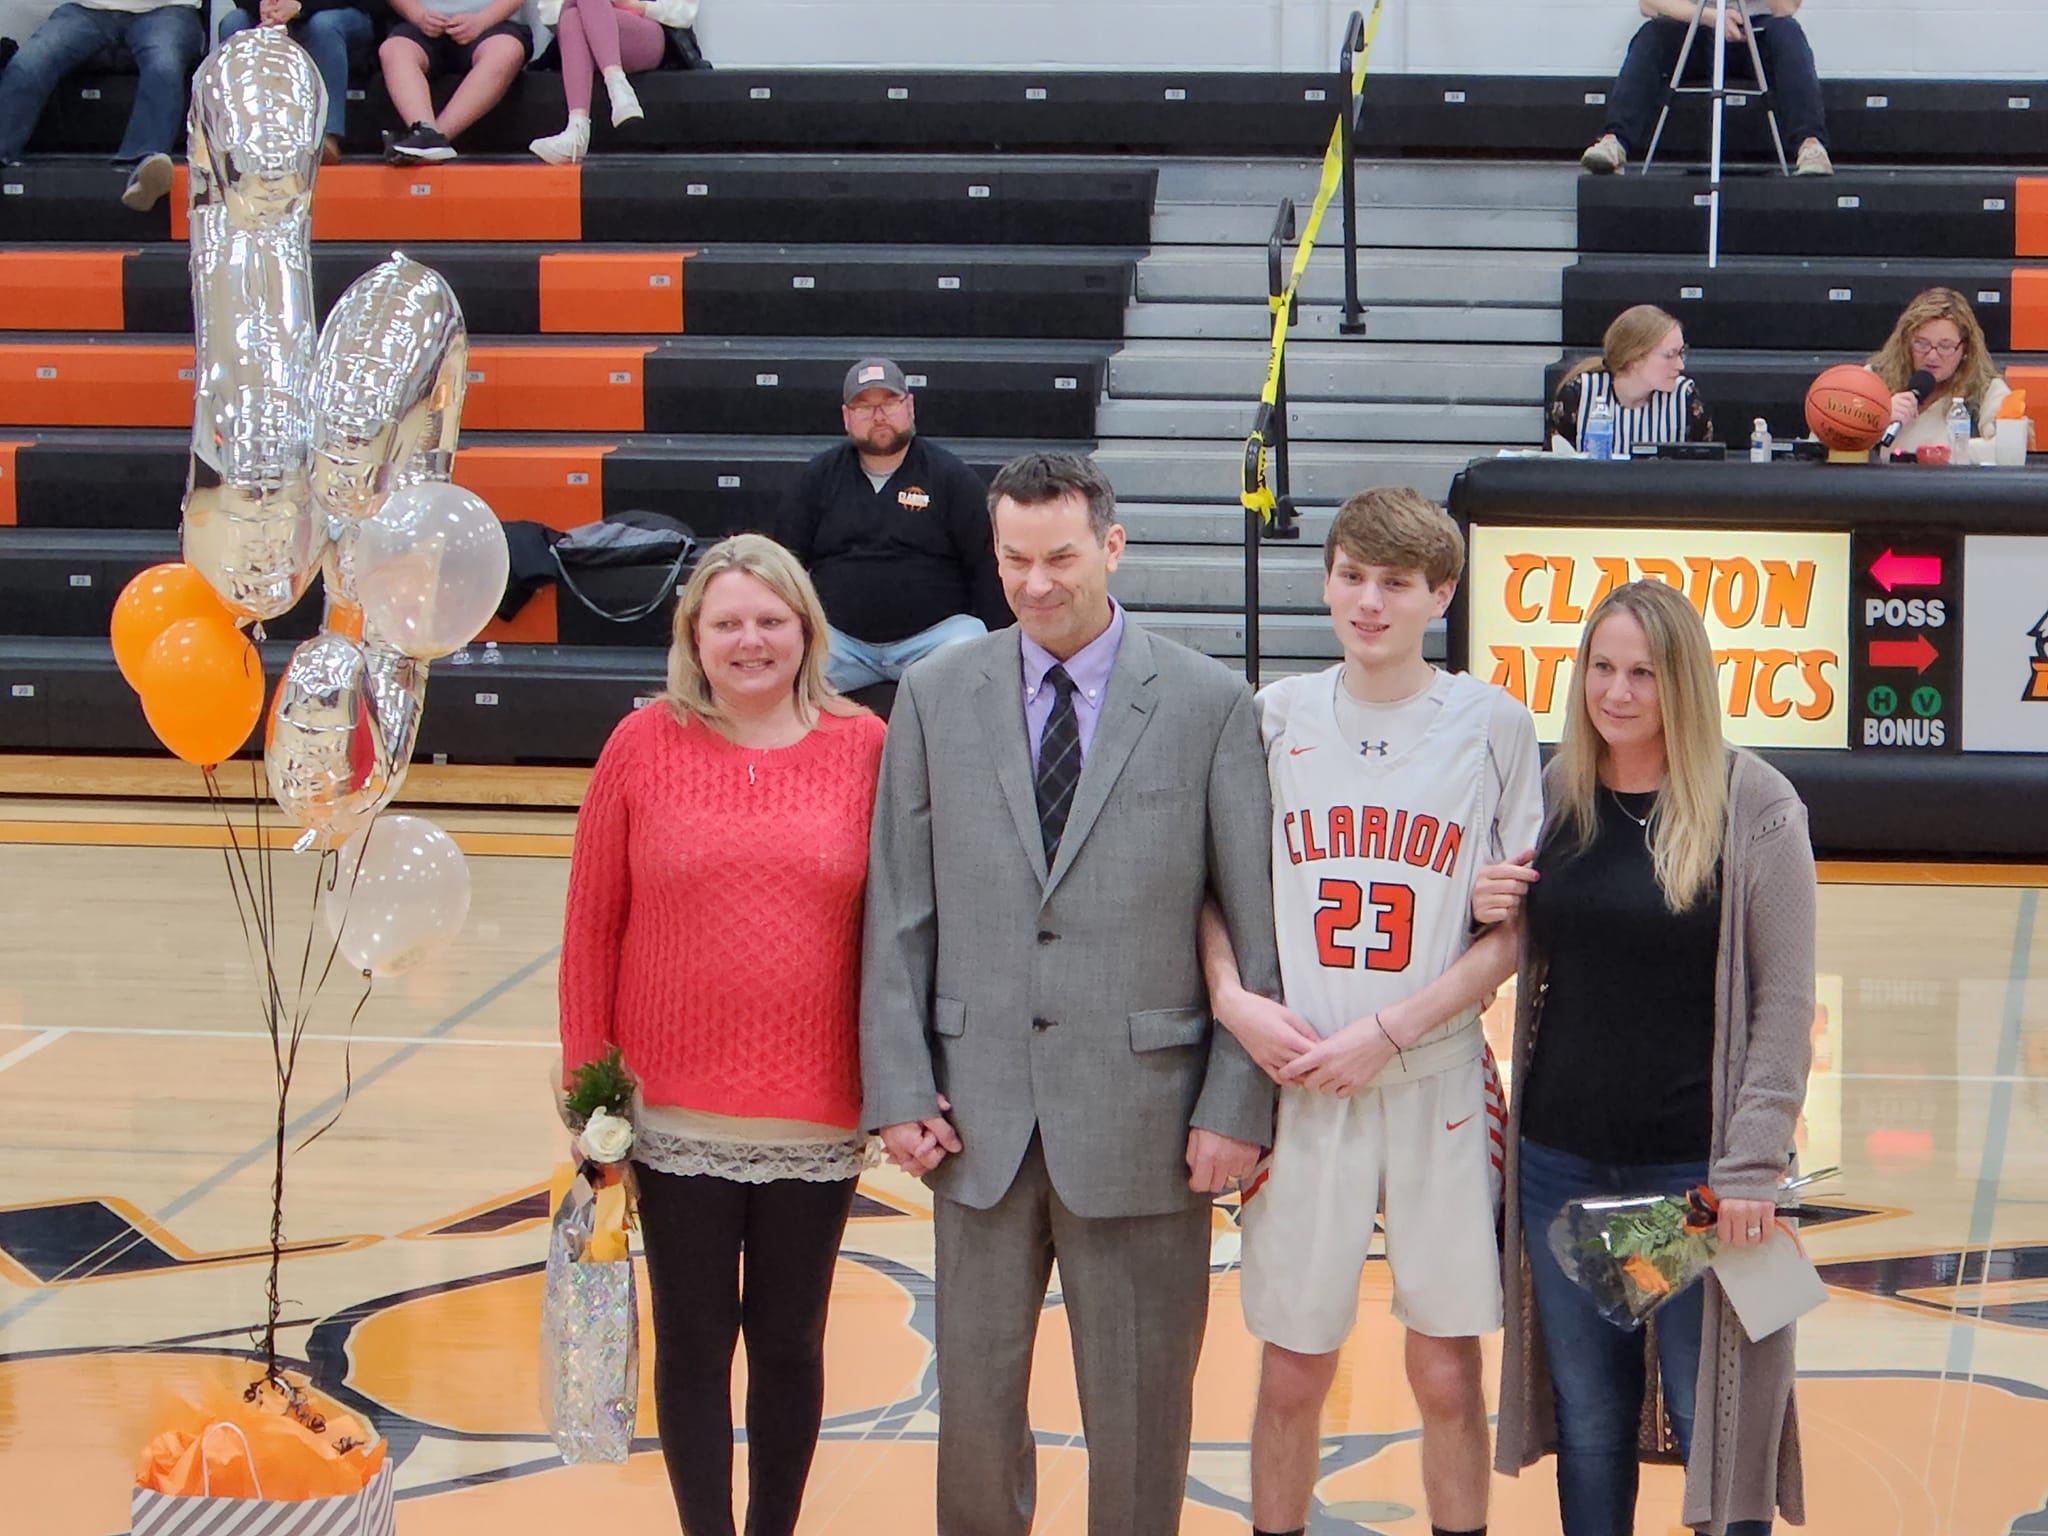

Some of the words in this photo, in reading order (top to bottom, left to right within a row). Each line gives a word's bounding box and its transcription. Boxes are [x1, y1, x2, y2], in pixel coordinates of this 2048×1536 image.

[1503, 553, 1817, 629] CLAION
[1865, 598, 1946, 627] POSS
[1488, 645, 1839, 720] ATICS
[1873, 692, 1891, 711] H
[1917, 693, 1936, 713] V
[1863, 717, 1946, 747] BONUS
[1283, 804, 1466, 878] CLARION
[1314, 877, 1416, 973] 23
